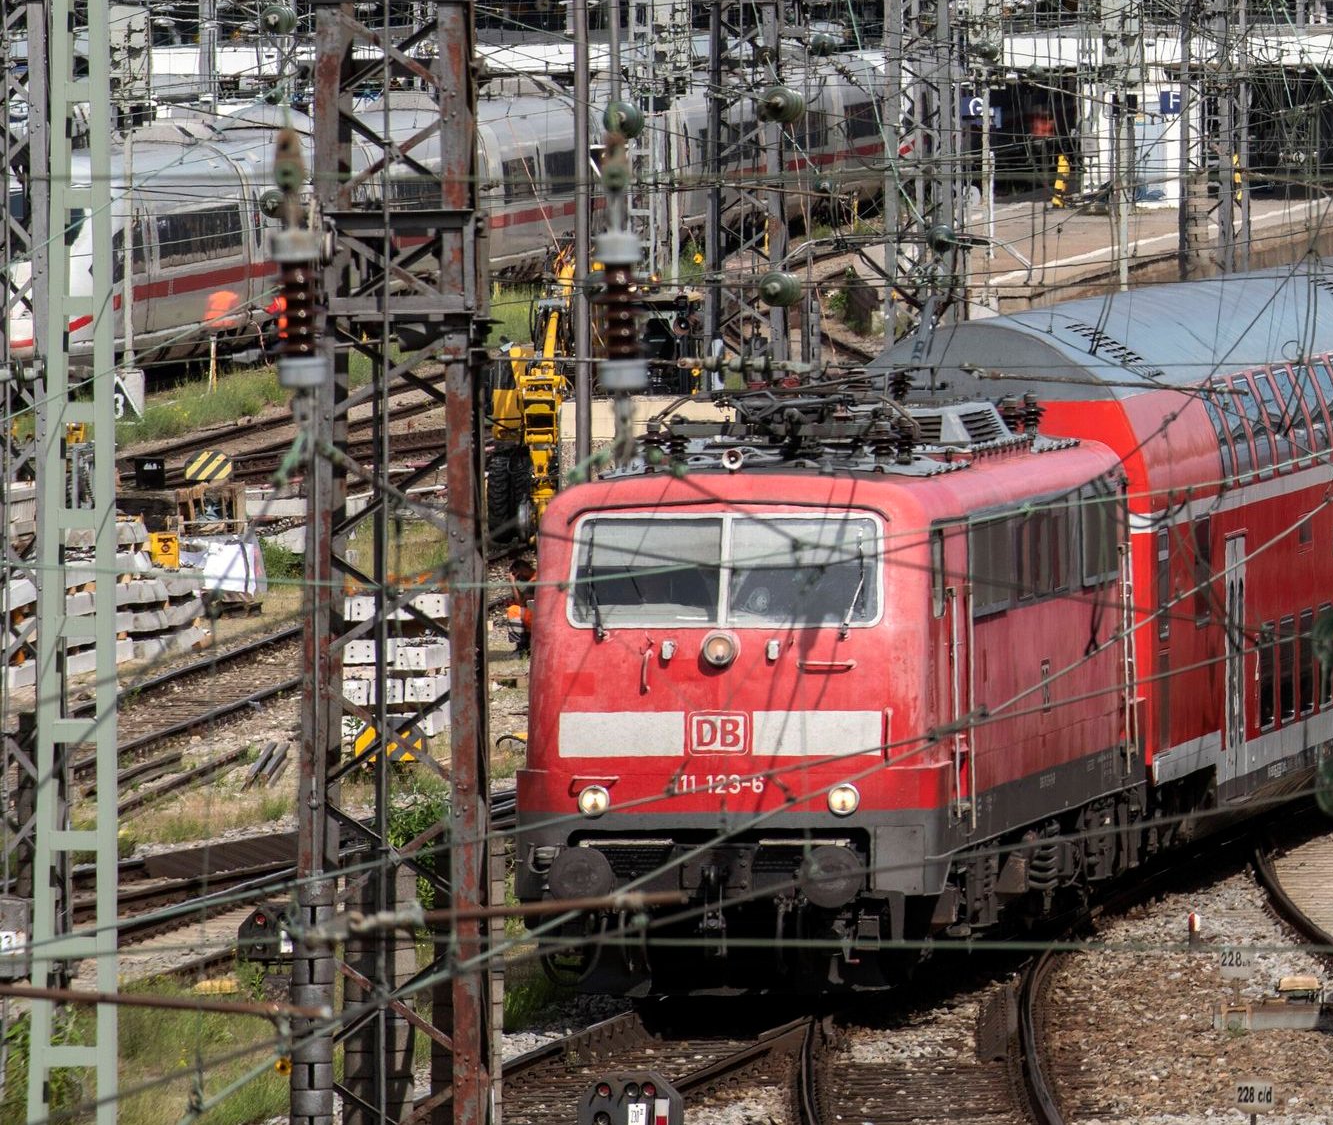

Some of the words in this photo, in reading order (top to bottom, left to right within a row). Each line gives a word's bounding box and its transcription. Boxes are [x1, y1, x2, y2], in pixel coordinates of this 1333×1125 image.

[1169, 91, 1181, 109] F
[114, 393, 125, 419] 3
[696, 719, 742, 748] DB
[706, 774, 765, 794] 123-6
